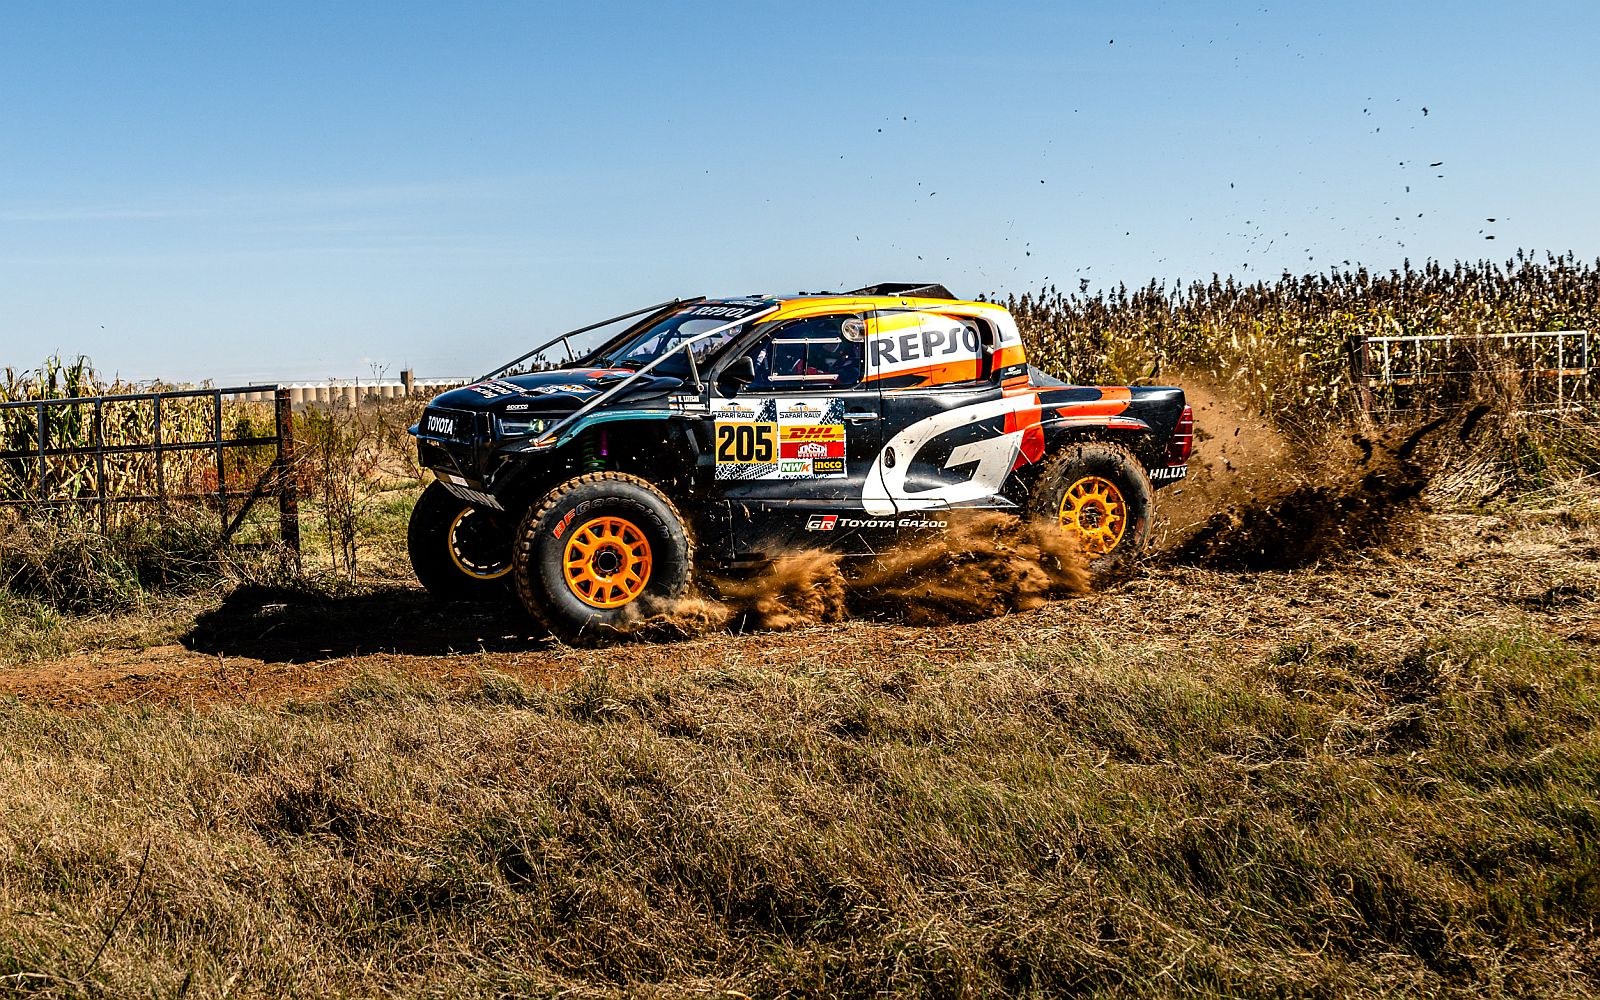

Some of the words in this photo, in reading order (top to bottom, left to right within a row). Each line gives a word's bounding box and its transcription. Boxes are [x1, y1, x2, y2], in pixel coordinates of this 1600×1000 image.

[690, 306, 753, 318] REPSOL
[779, 411, 803, 419] SAFARI
[427, 416, 453, 435] TOYOTA
[789, 427, 836, 439] DHL
[718, 425, 773, 462] 205
[798, 443, 828, 453] JONSSON
[781, 462, 811, 473] NWK
[1150, 466, 1188, 480] HILUX
[808, 520, 833, 529] GR
[839, 518, 895, 528] TOYOTA
[898, 518, 948, 528] GAZOO
